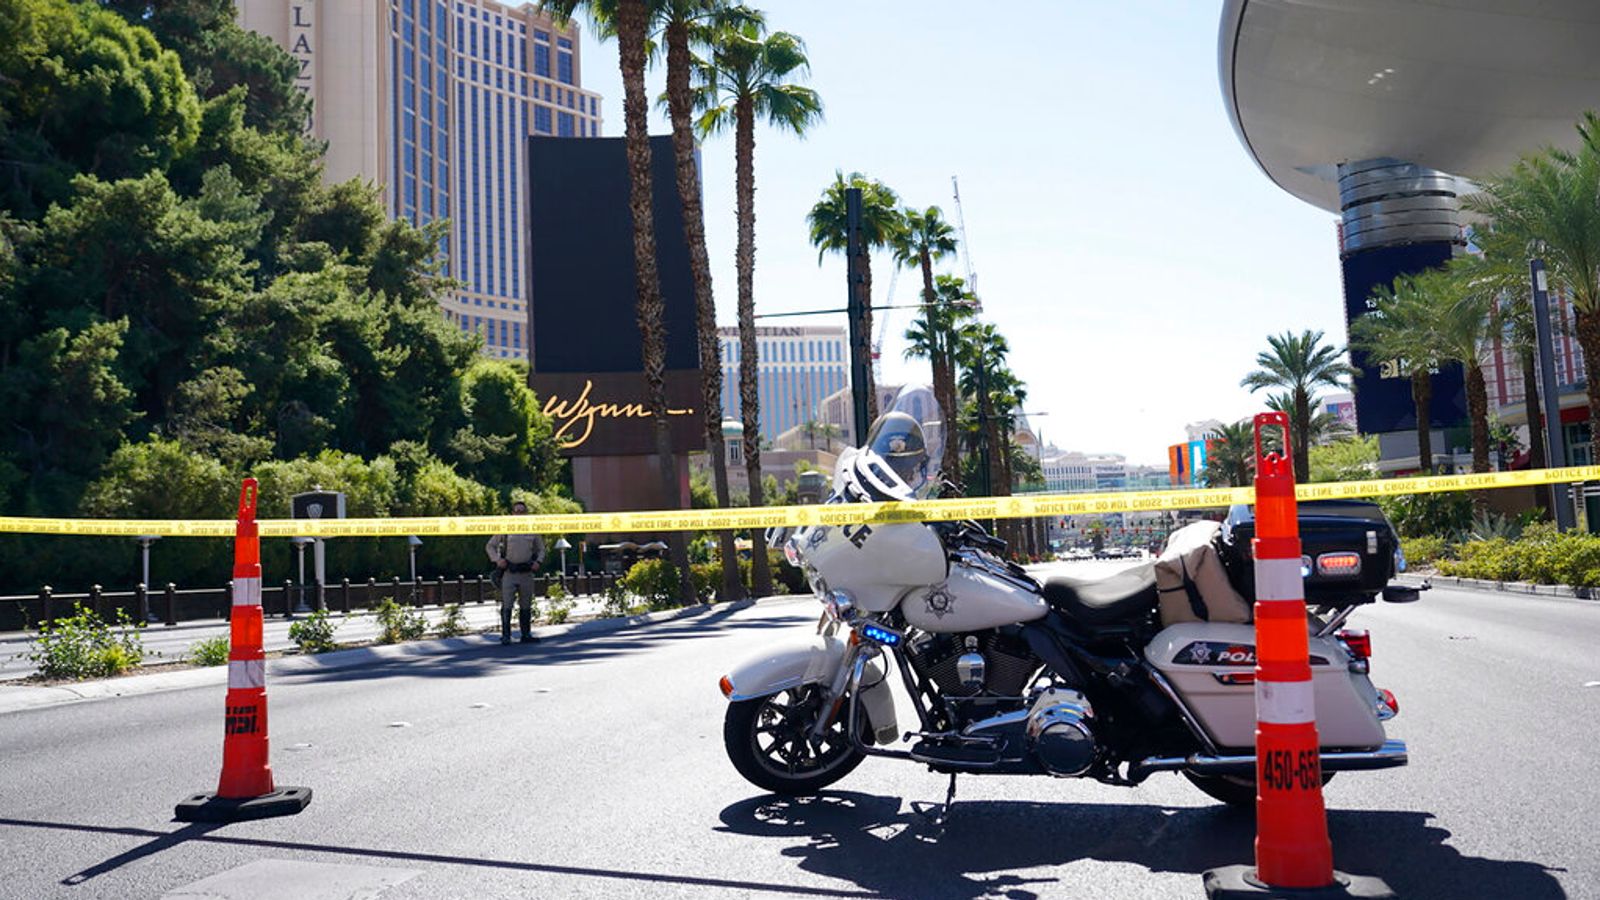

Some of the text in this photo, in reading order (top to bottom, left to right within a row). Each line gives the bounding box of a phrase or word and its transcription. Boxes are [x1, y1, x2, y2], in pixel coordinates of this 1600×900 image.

[292, 6, 313, 132] LAZ
[1217, 651, 1256, 662] POL
[1264, 750, 1320, 790] 450-65
